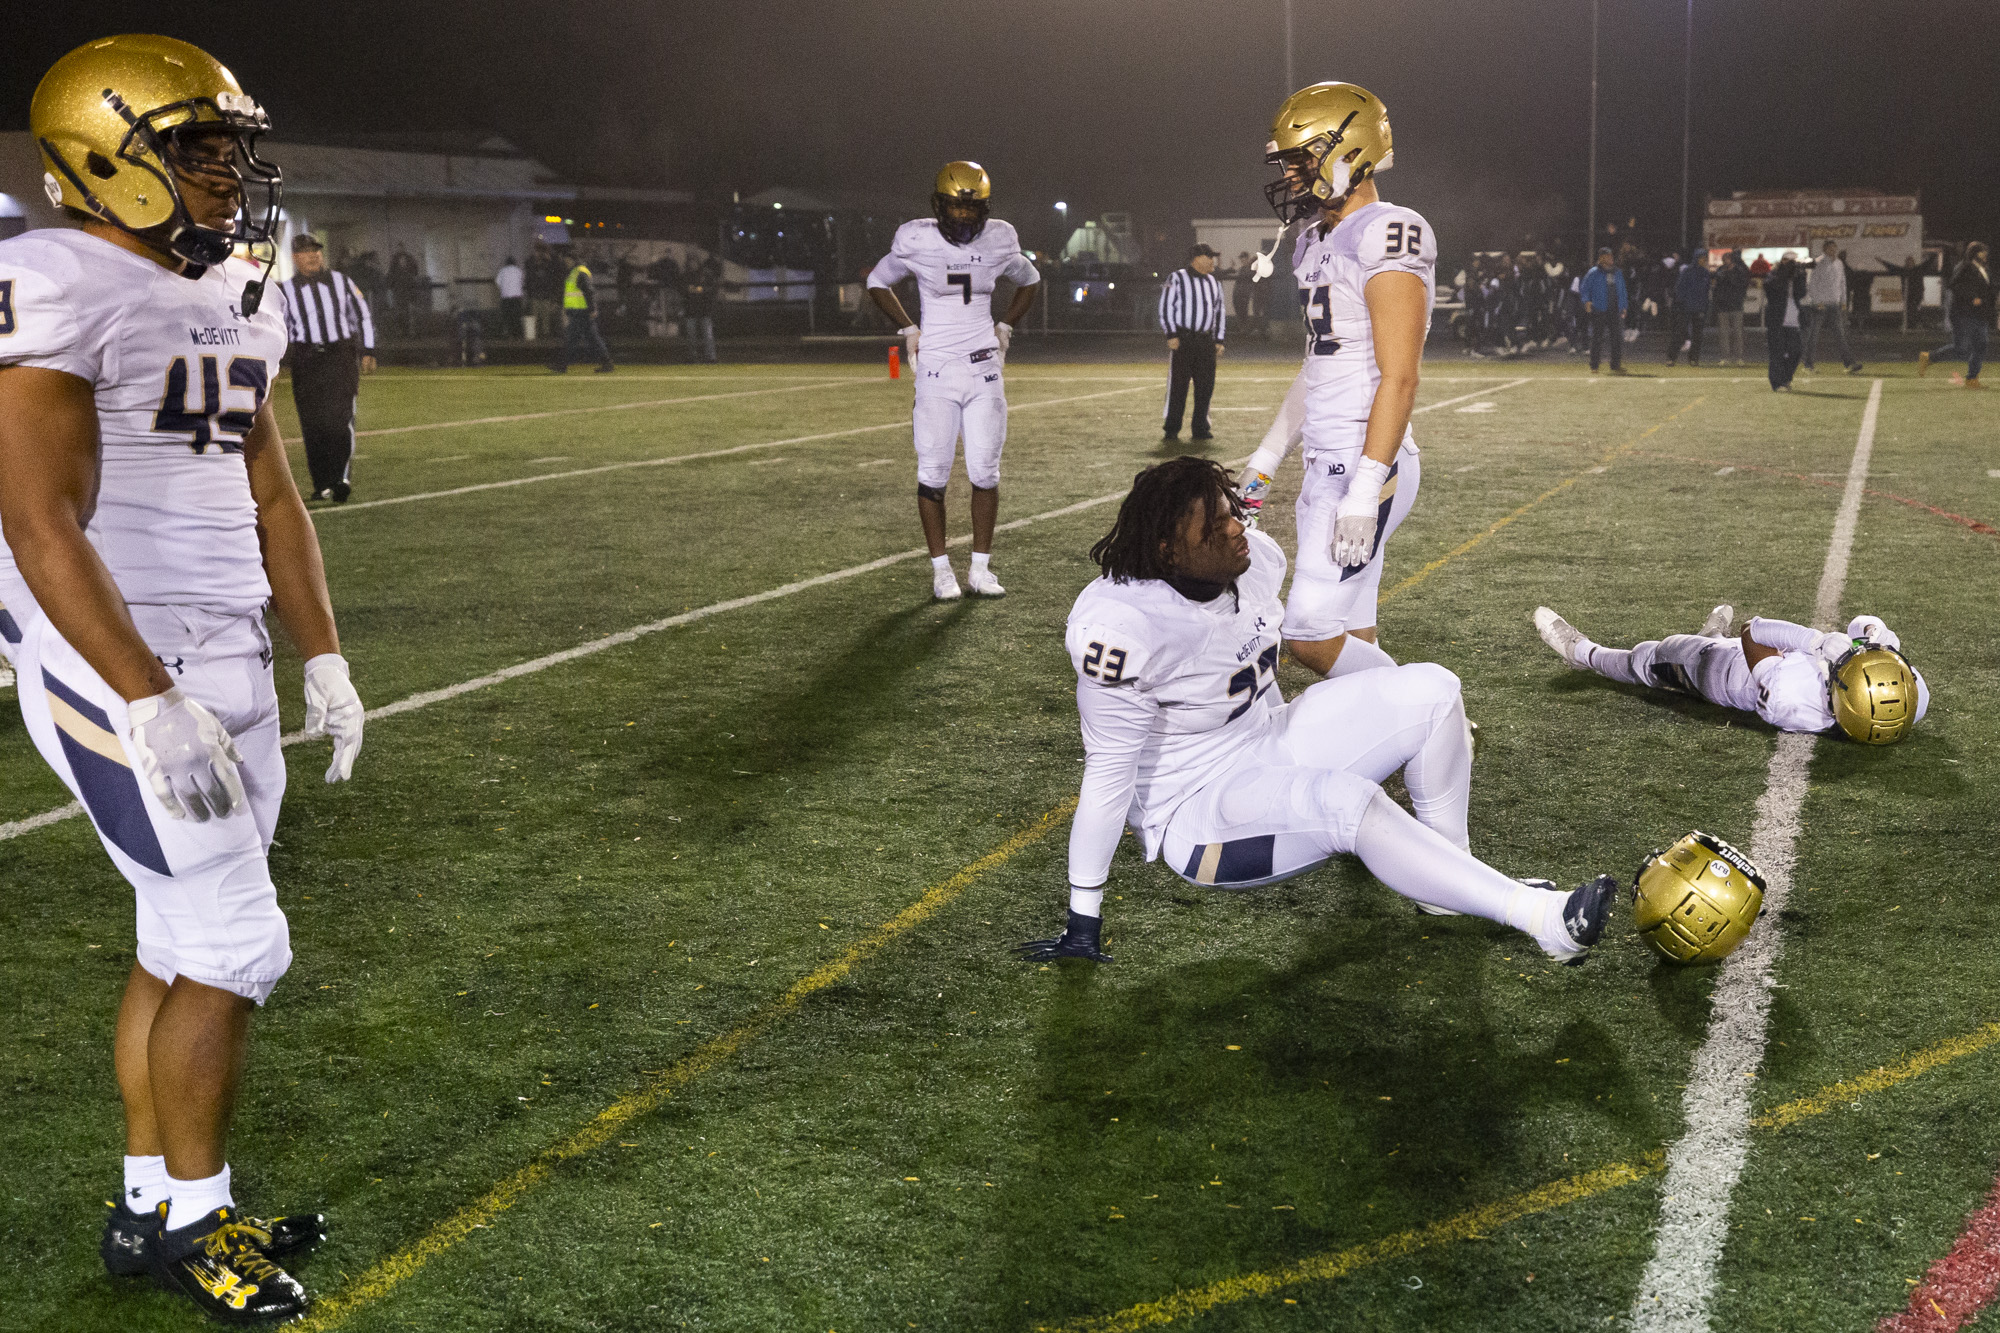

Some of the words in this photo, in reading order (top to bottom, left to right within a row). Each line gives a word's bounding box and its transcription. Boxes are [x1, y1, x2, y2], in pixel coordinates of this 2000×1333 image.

[1386, 222, 1422, 257] 32
[947, 274, 971, 305] 7
[190, 327, 240, 346] McDEVITT
[1083, 640, 1129, 683] 23
[1235, 635, 1261, 663] McDEVITT
[1711, 861, 1730, 876] BJV
